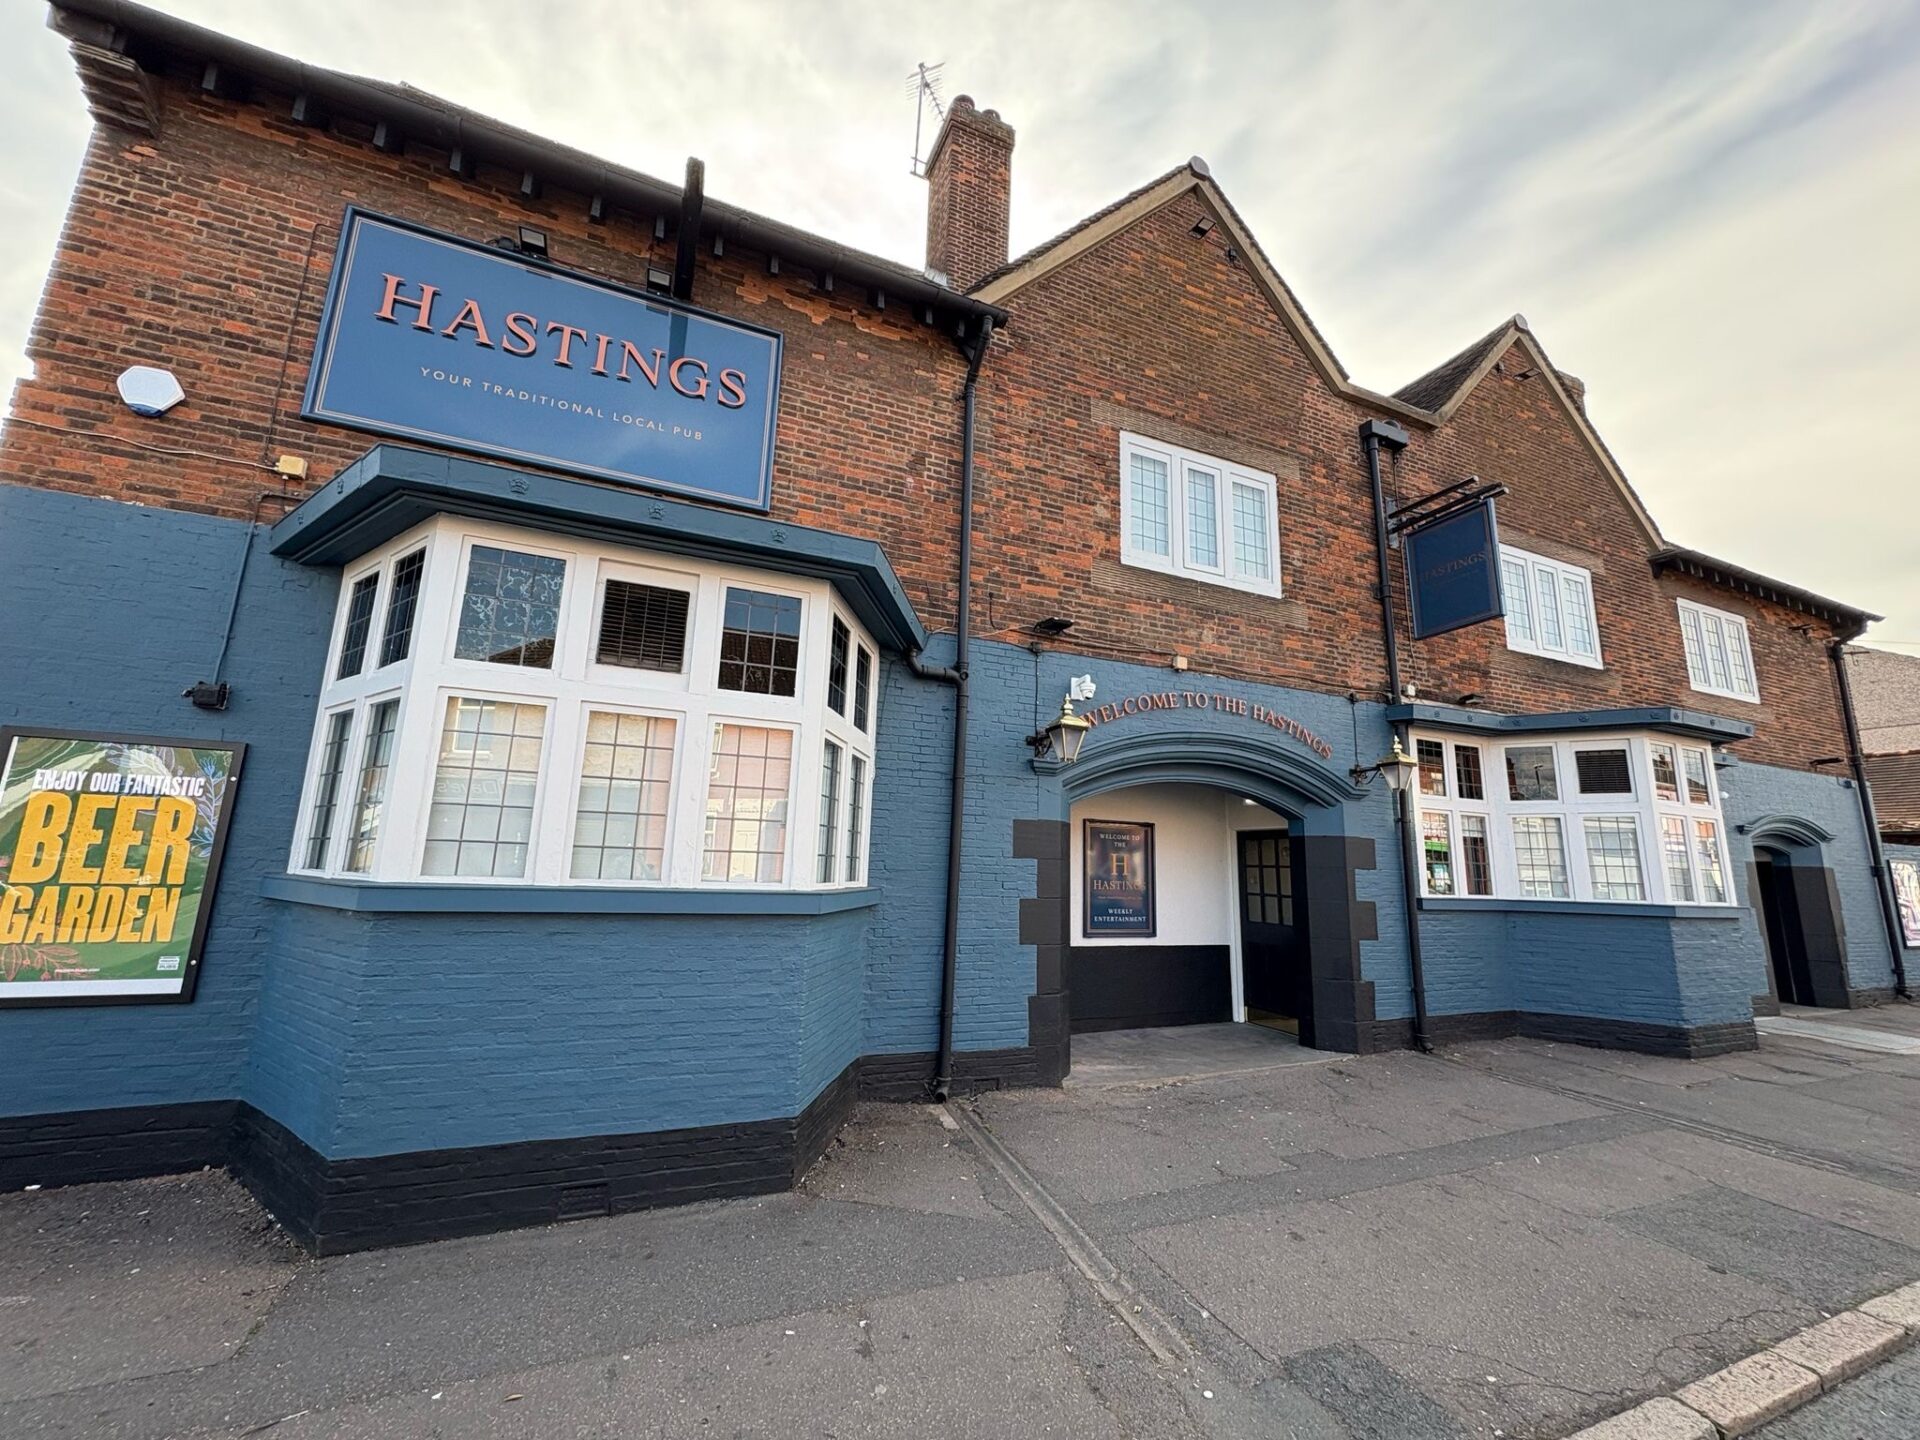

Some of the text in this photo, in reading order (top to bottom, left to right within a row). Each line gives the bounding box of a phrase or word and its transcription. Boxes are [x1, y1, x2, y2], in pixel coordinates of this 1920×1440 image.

[373, 272, 747, 409] HASTINGS
[420, 366, 703, 440] YOUR TRADITIONAL LOCAL PUB
[1079, 691, 1333, 759] WELCOME TO THE HASTINGS
[31, 769, 206, 797] ENJOY OUR FANTASTIC
[7, 790, 198, 885] BEER
[1099, 833, 1130, 841] WELCOME
[1110, 853, 1130, 876] H
[0, 885, 182, 944] GARDEN
[1108, 907, 1133, 915] WEEKLY
